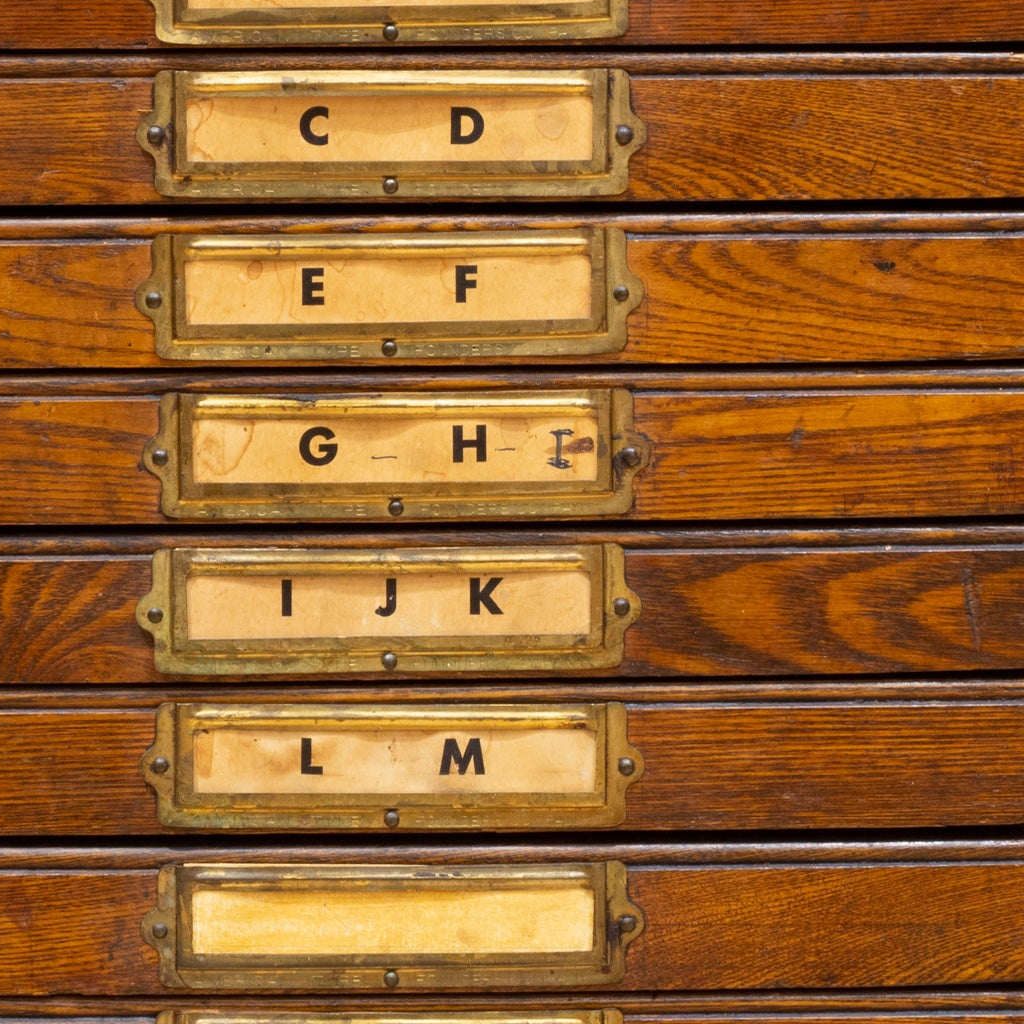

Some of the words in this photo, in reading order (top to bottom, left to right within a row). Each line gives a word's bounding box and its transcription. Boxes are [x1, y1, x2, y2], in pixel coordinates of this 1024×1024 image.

[298, 106, 329, 146] C
[450, 107, 485, 145] D
[302, 268, 325, 306] E
[454, 265, 478, 302] F
[298, 426, 338, 466] G
[452, 425, 486, 463] H
[546, 428, 574, 470] I
[281, 580, 292, 616] I
[376, 578, 397, 617] J
[469, 577, 504, 616] K
[300, 738, 324, 775] L
[440, 738, 486, 776] M
